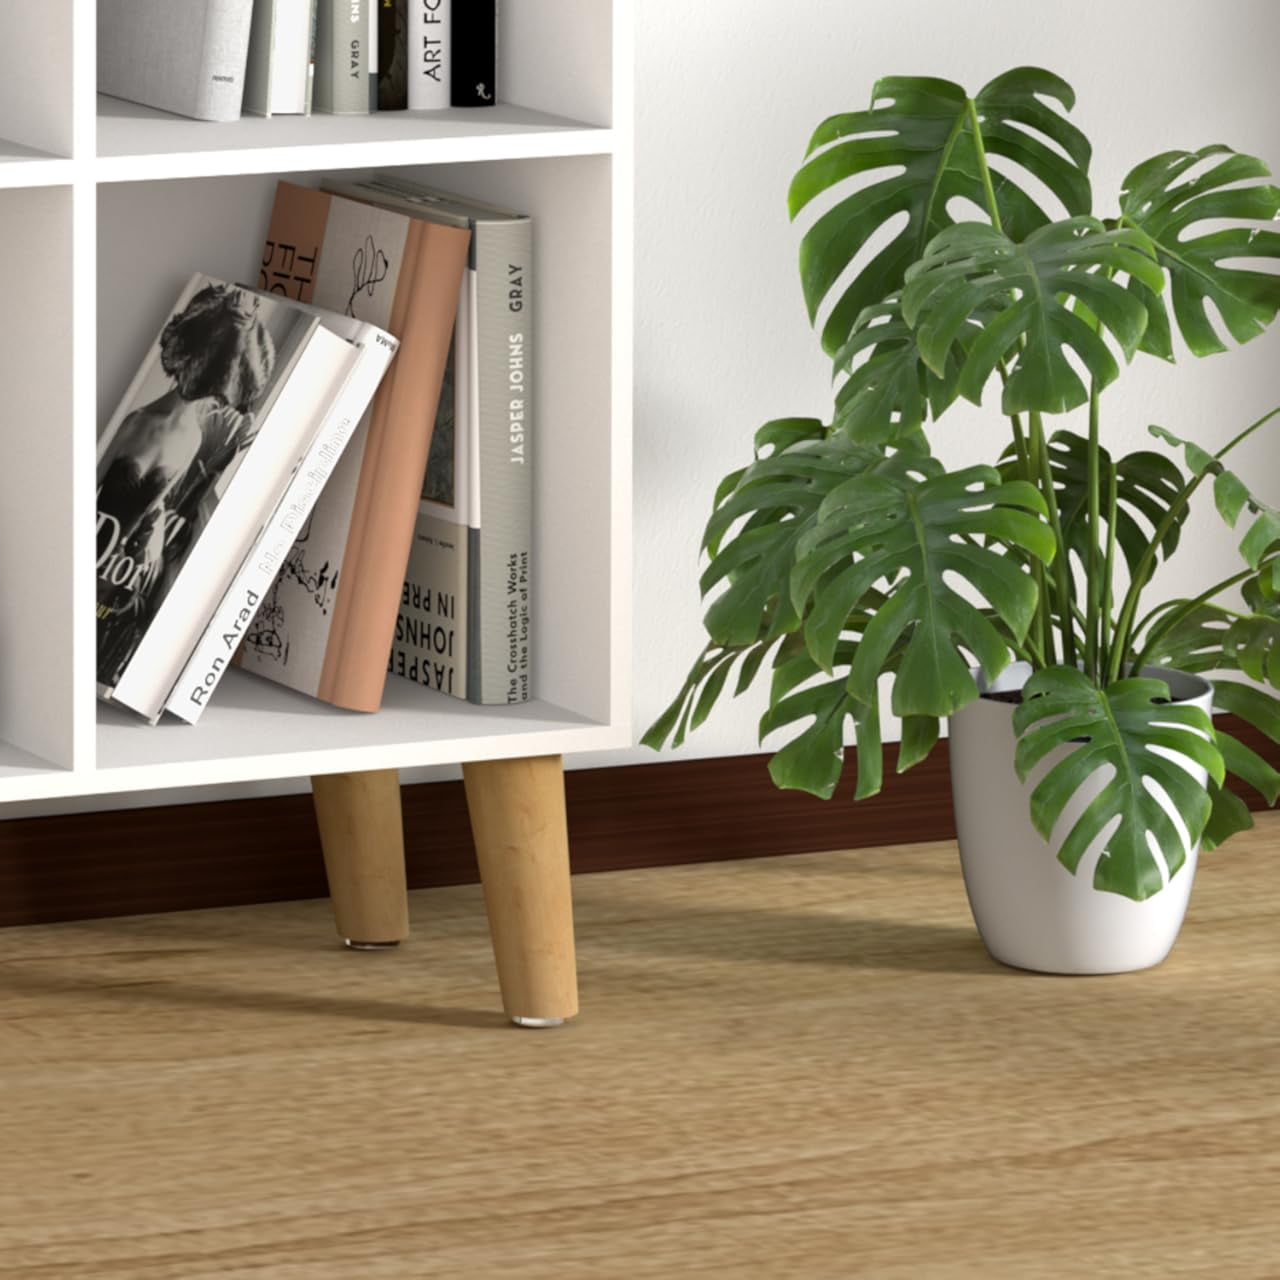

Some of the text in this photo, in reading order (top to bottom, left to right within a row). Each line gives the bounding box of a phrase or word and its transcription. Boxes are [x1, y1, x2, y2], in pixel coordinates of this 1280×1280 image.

[350, 40, 360, 79] GRAY
[423, 36, 441, 82] ART
[508, 264, 523, 312] GRAY
[509, 332, 524, 464] JASPER JOHNS
[403, 581, 454, 619] IN PRE
[190, 589, 260, 706] Ron Arad
[396, 613, 454, 657] JOHNS
[507, 553, 518, 704] The Crosshatch Works
[520, 551, 530, 701] and the Logic of Print
